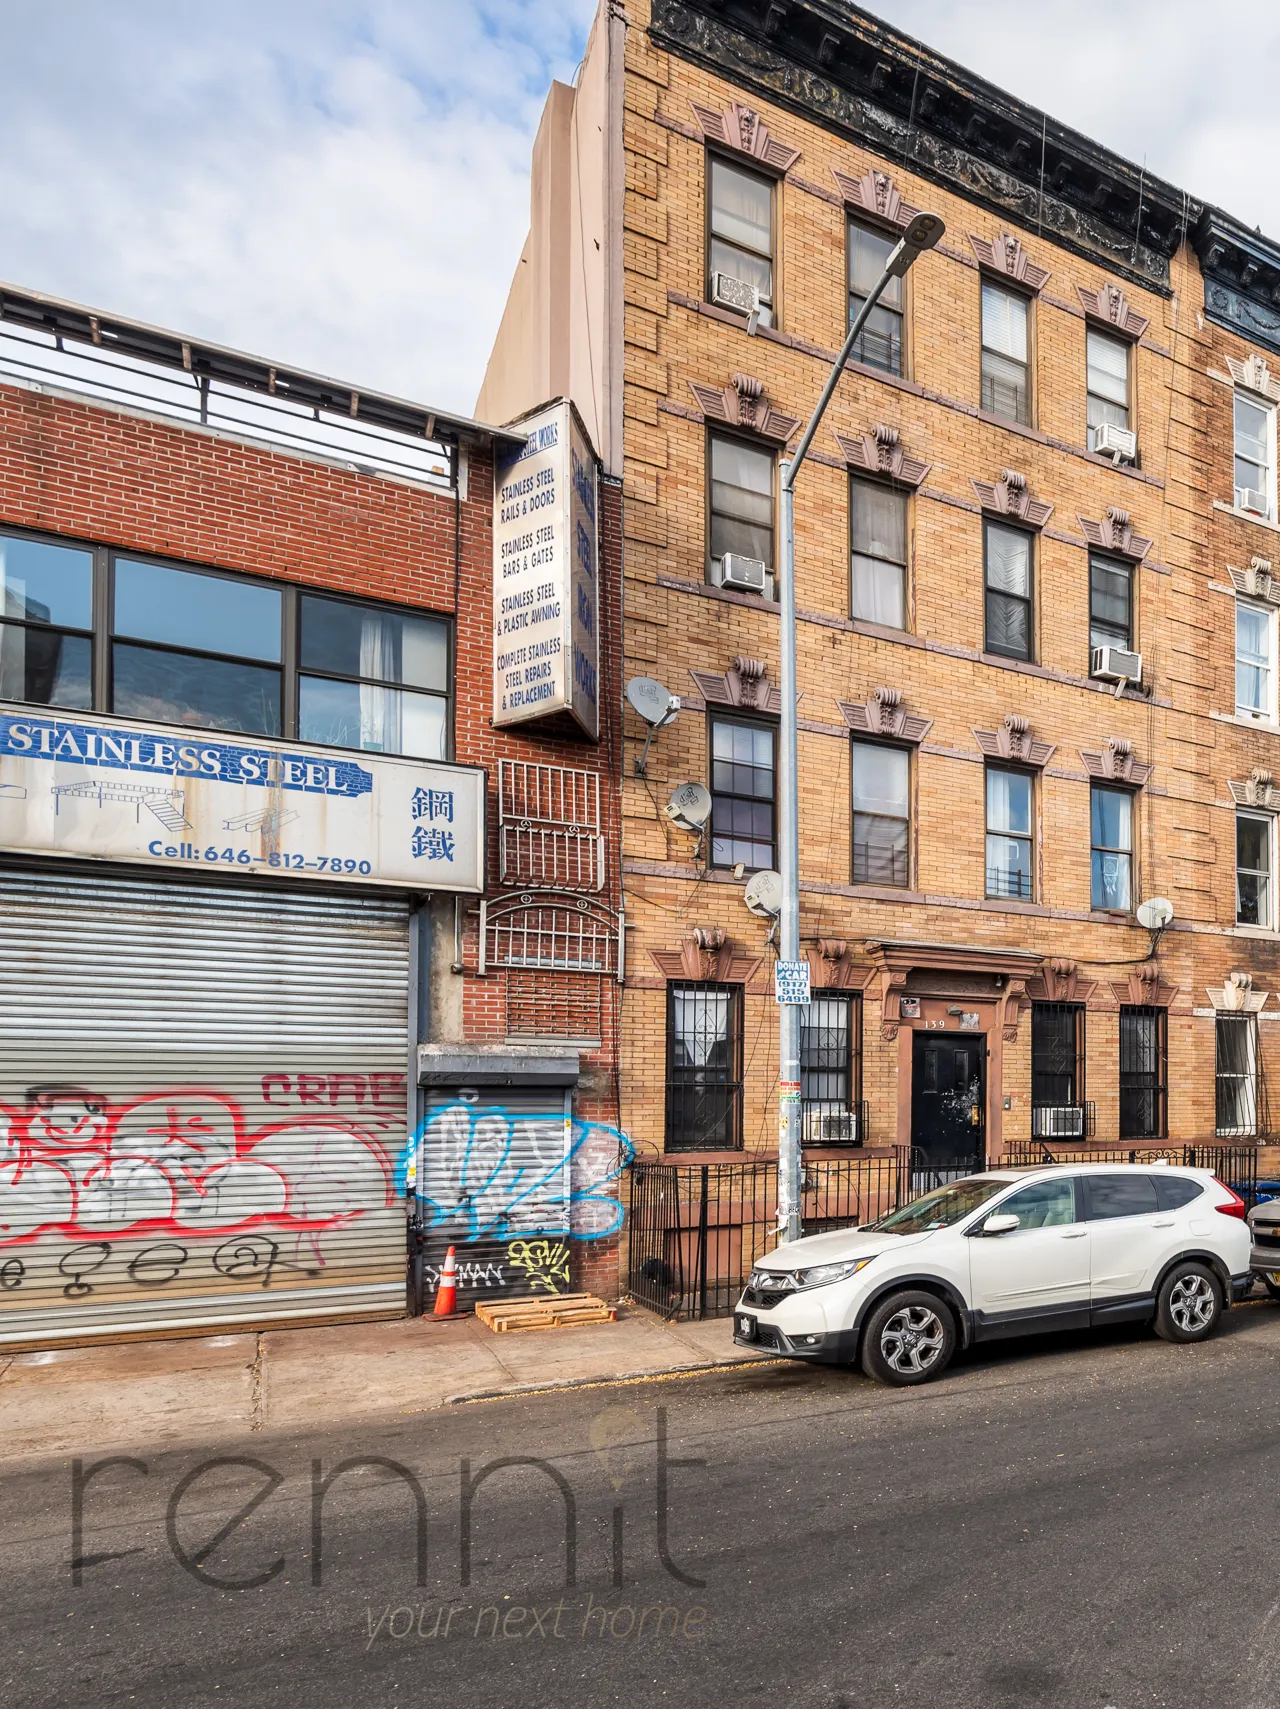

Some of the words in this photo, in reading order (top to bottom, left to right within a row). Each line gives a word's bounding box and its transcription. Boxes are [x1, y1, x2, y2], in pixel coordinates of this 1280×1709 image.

[539, 422, 558, 449] WORKS
[501, 476, 534, 504] STAINLESS
[536, 468, 555, 488] STEEL
[501, 502, 520, 524] RAILS
[522, 502, 528, 515] &
[530, 488, 555, 512] DOORS
[501, 531, 534, 558] STAINLESS
[536, 525, 555, 544] STEEL
[503, 559, 521, 578] BARS
[523, 558, 529, 570] &
[531, 547, 554, 567] GATES
[501, 590, 534, 614] STAINLESS
[536, 582, 556, 601] STEEL
[497, 621, 503, 637] &
[504, 614, 529, 634] PLASTIC
[530, 602, 561, 625] AWNING
[497, 647, 527, 672] COMPLETE
[528, 637, 561, 661] STAINLESS
[505, 671, 523, 689] STEEL
[525, 661, 552, 683] REPAIRS
[502, 695, 507, 711] &
[509, 681, 556, 708] REPLACEMENT
[7, 723, 223, 775] STAINLESS
[239, 753, 348, 791] STEEL
[411, 786, 456, 863] 鋼鐵
[148, 840, 200, 861] Cell:
[777, 961, 808, 971] DONATE
[785, 970, 808, 980] CAR
[777, 995, 809, 1003] 6499
[782, 988, 805, 996] 515
[925, 1020, 945, 1029] 139
